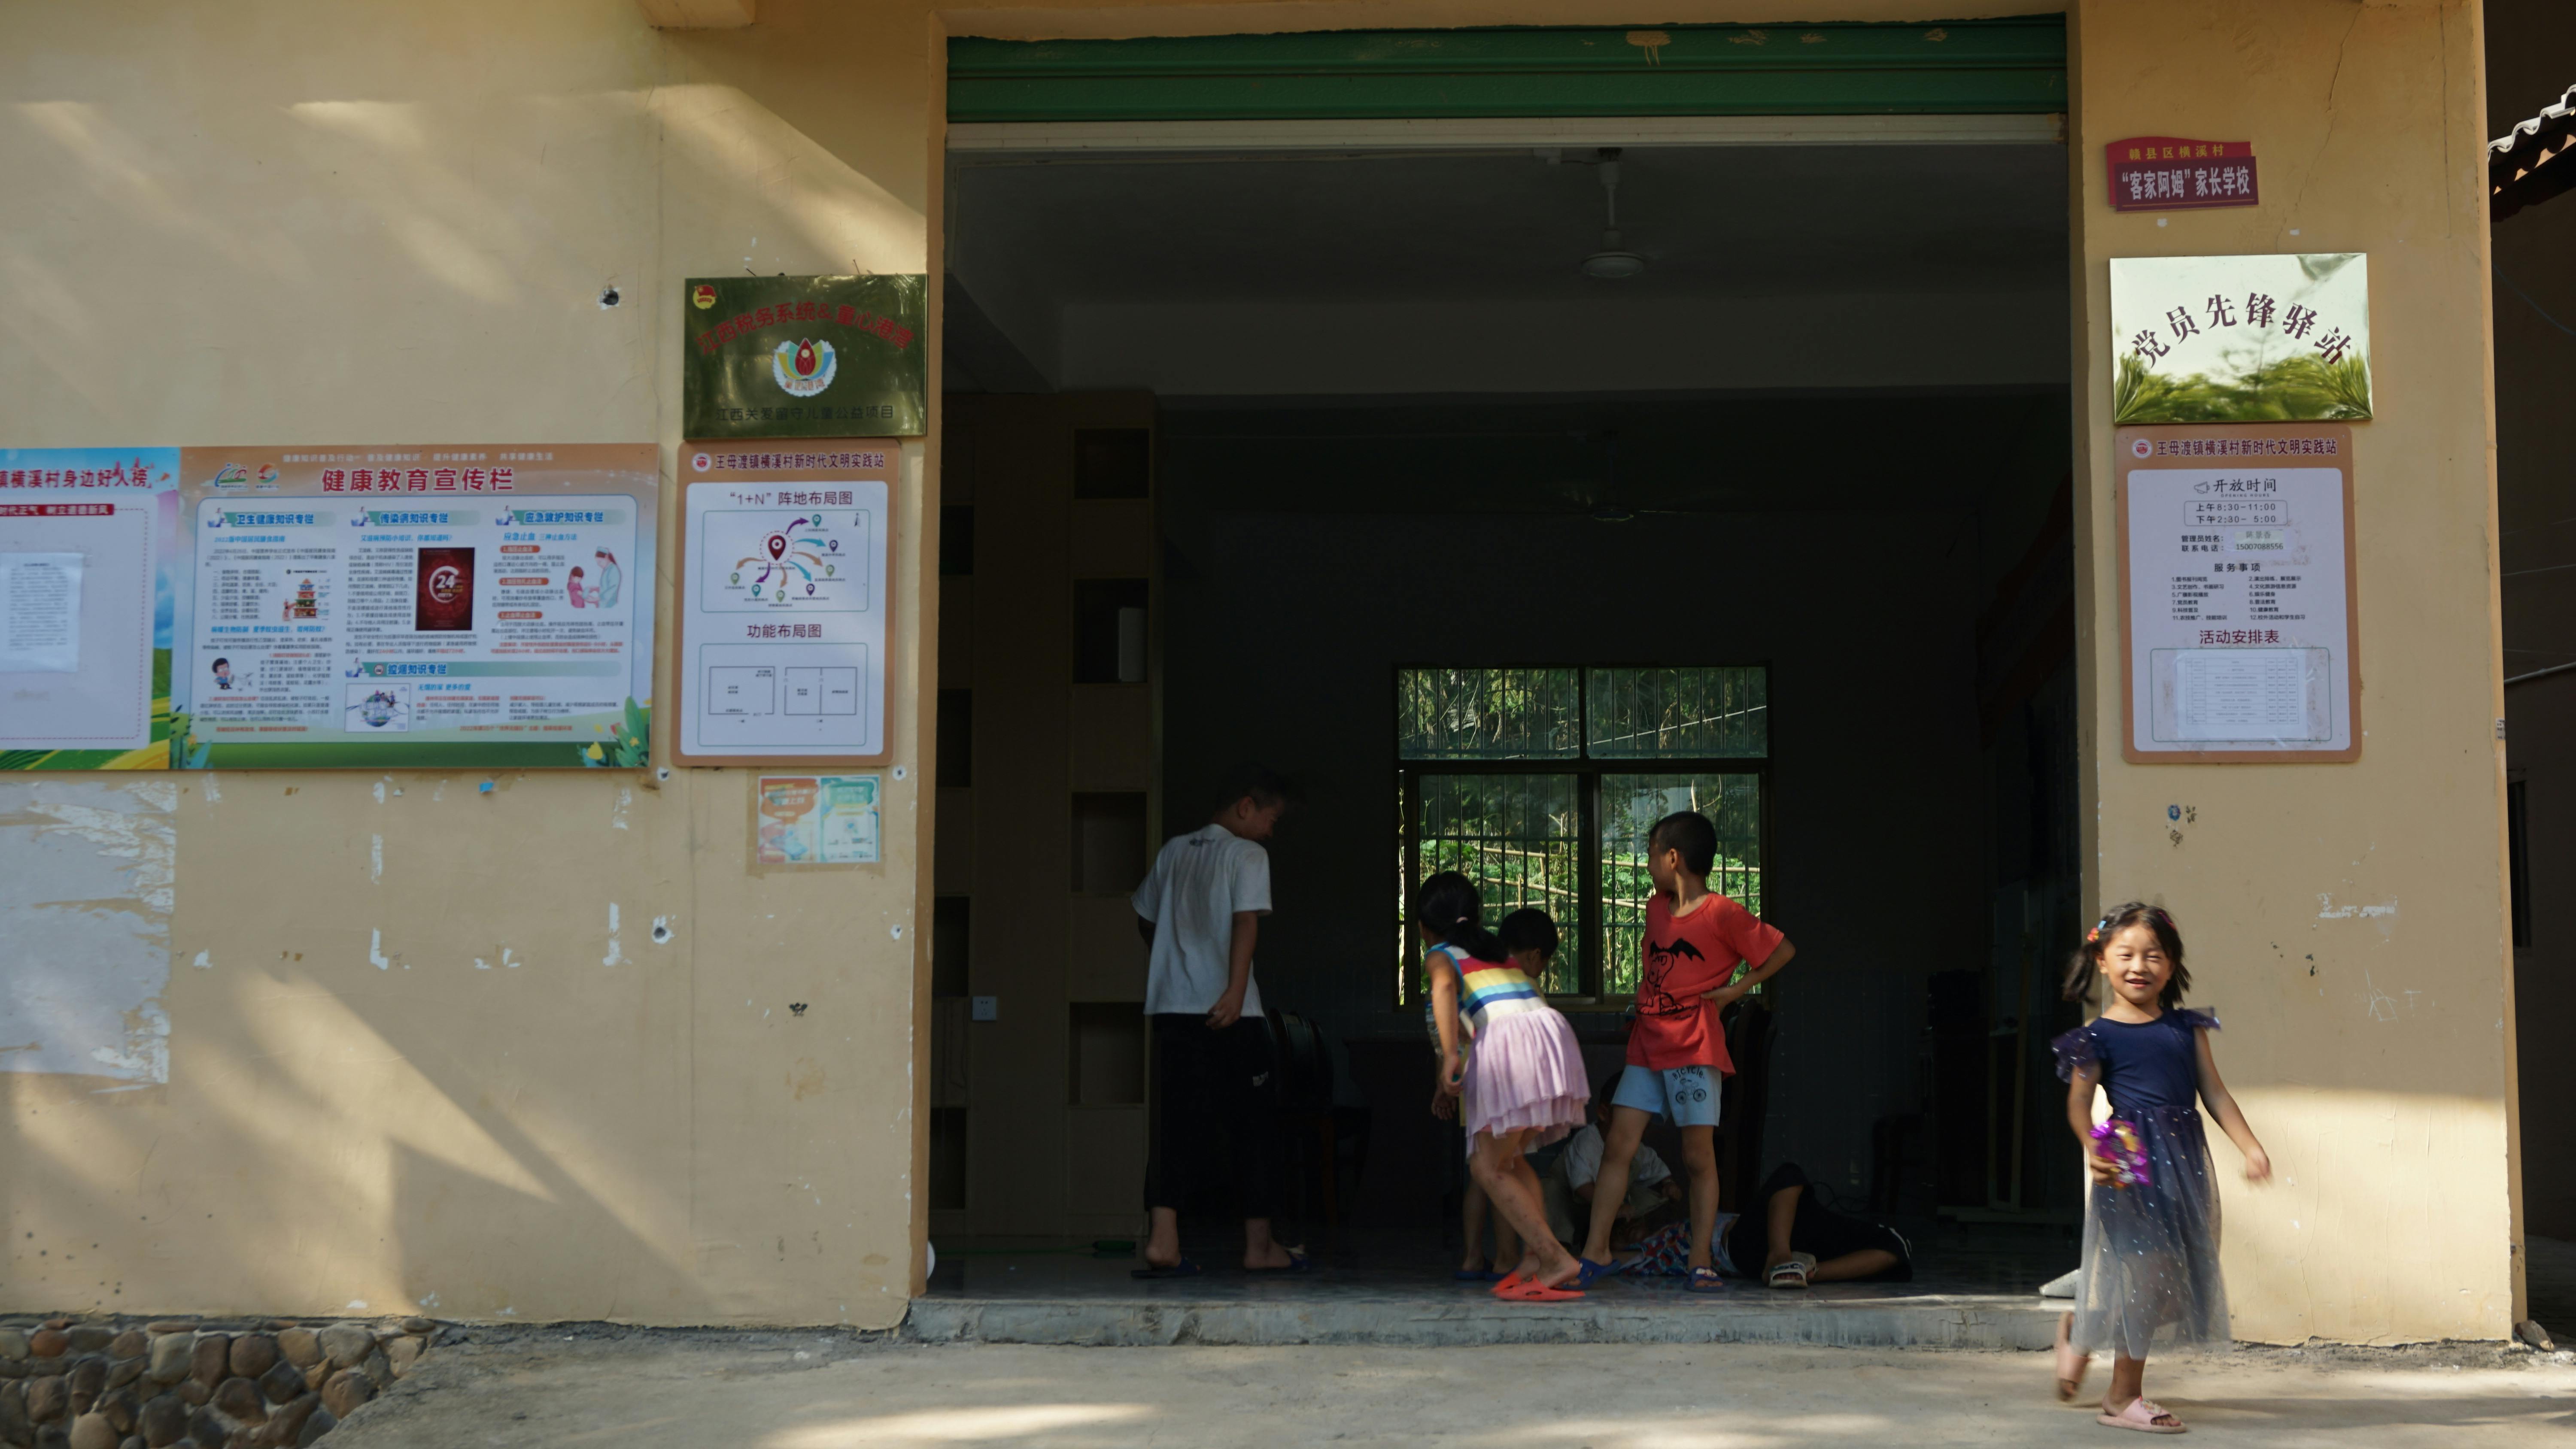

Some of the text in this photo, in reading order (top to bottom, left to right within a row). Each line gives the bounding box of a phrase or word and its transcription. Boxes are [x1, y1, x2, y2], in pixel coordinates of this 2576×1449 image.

[2129, 144, 2224, 160] 赣县区横溪村
[2122, 166, 2250, 200] “客家阿姆”家长学校
[695, 301, 914, 356] 江西税务系统&童心港湾
[2131, 292, 2351, 368] 党员先锋驿站
[716, 405, 893, 421] 江西关爱留守儿童公益项目
[2157, 439, 2337, 456] 王母渡镇横溪村新时代文明实践站
[716, 453, 884, 469] 王母渡镇横溪村新时代文明实践站
[322, 468, 513, 492] 健康教育宣传栏
[2213, 478, 2276, 493] 开放时间
[237, 514, 314, 524] 卫生健康知识专栏
[380, 513, 448, 523] 传染病知识专栏
[524, 512, 603, 522] 应急救护知识专栏
[2215, 563, 2260, 572] 服务事项
[436, 575, 454, 588] 24
[747, 624, 822, 638] 功能布局图
[2199, 629, 2280, 644] 活动安排表
[388, 664, 447, 674] 控烟知识专栏
